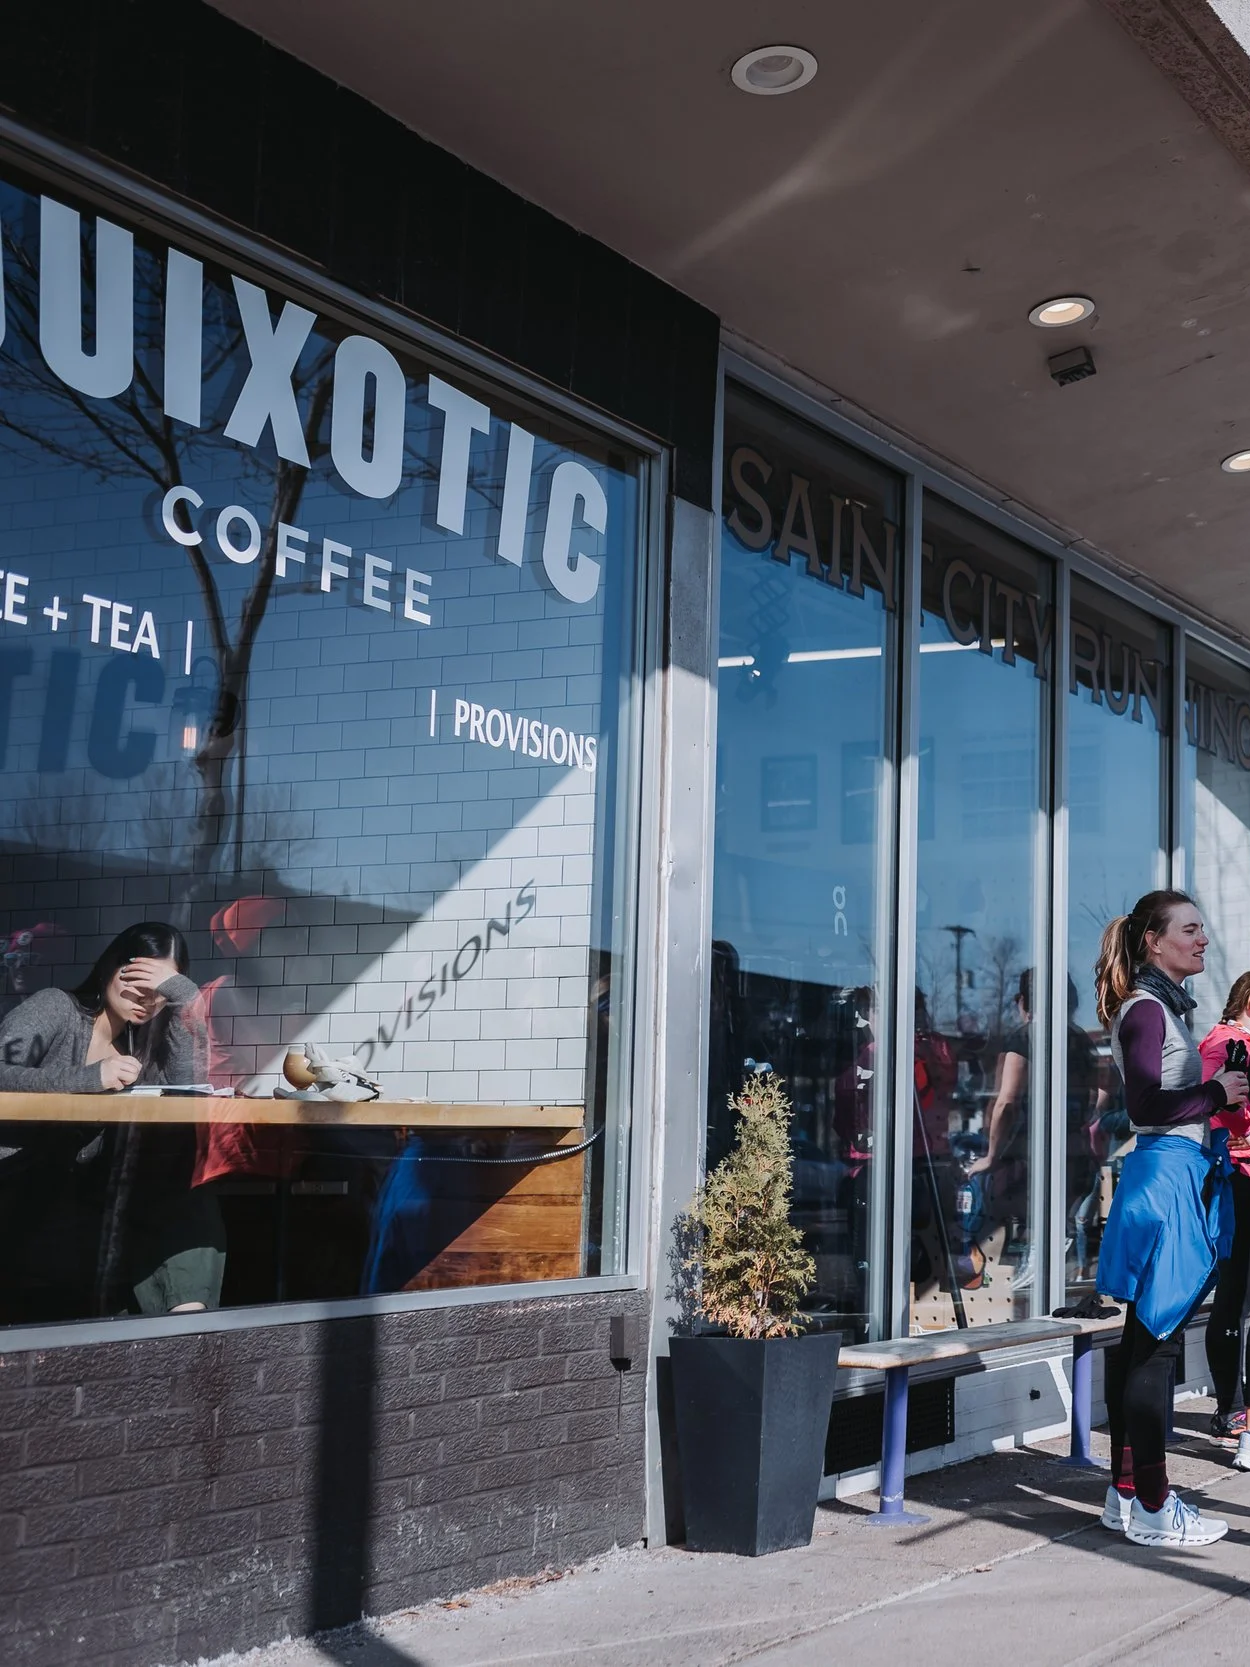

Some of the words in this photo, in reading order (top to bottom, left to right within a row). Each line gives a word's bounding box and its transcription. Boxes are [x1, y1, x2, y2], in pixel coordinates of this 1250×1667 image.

[0, 194, 608, 604] UIXOTIC
[0, 569, 30, 625] E
[82, 594, 160, 660] TEA
[162, 485, 432, 625] COFFEE
[943, 557, 1053, 681] CITY
[454, 698, 597, 773] PROVISIONS
